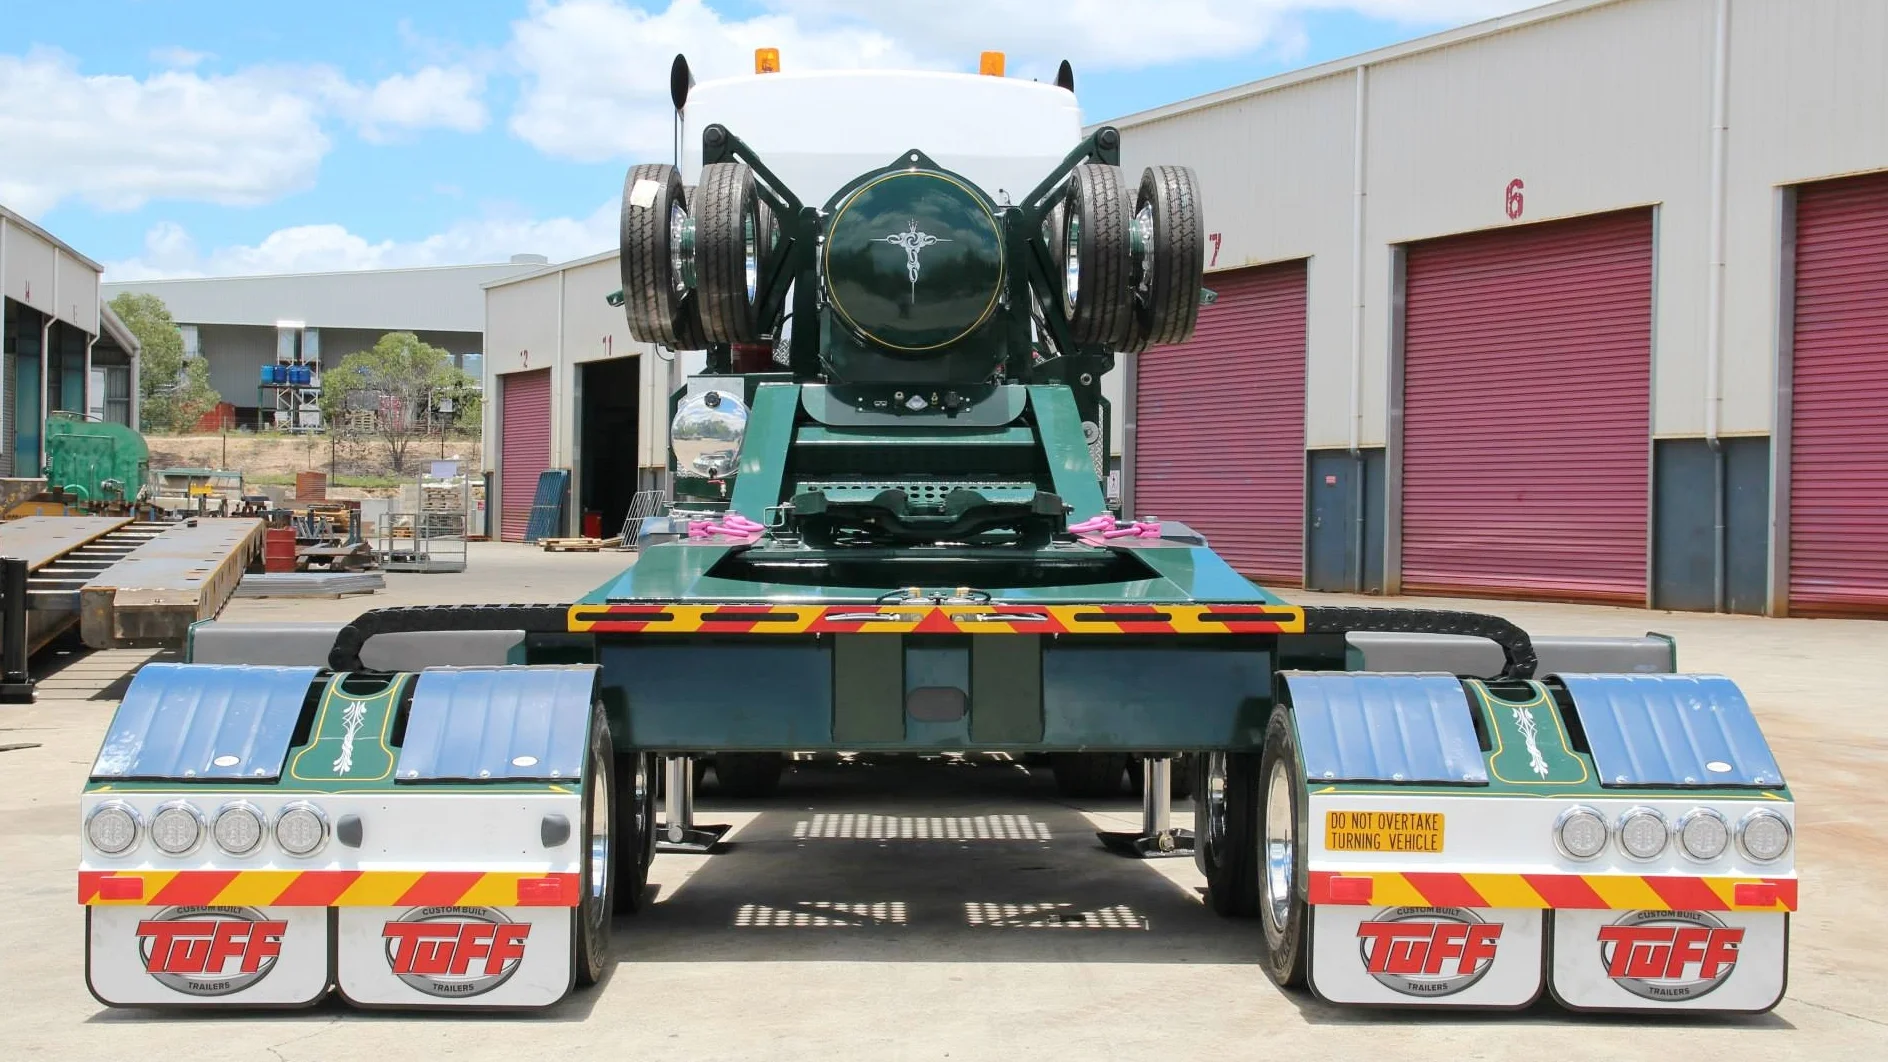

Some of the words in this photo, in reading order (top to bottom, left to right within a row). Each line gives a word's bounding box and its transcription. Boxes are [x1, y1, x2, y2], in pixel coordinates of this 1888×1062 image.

[1506, 178, 1524, 220] 6
[1209, 233, 1221, 267] 7
[1331, 813, 1346, 829] DO
[1352, 813, 1373, 829] NOT
[1378, 814, 1439, 831] OVERTAKE
[1332, 833, 1381, 850] TURNING
[1389, 834, 1438, 851] VEHICLE
[422, 906, 460, 915] CUSTOM
[462, 906, 487, 917] BUILT
[188, 981, 230, 991] TRAILERS
[433, 983, 474, 992] TRAILERS
[1408, 982, 1448, 992] TRAILERS
[1649, 986, 1690, 996] TRAILERS
